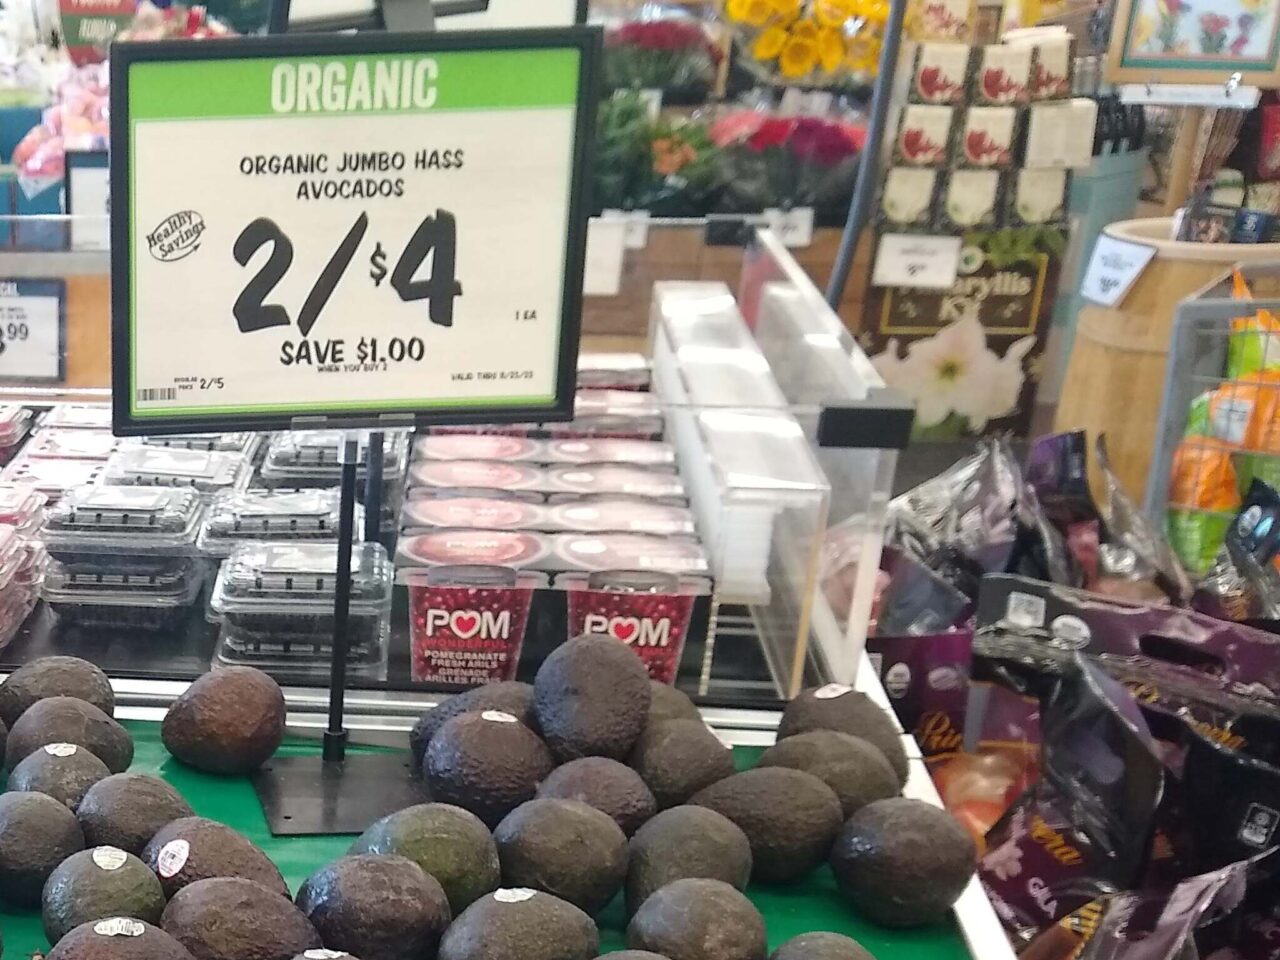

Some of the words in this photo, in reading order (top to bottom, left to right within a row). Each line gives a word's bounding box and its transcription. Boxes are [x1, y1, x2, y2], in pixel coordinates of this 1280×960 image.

[271, 59, 438, 114] ORGANIC
[240, 153, 328, 176] ORGANIC
[337, 152, 406, 173] JUMBO
[414, 149, 464, 170] HASS
[296, 178, 405, 200] AVOCADOS
[146, 209, 193, 248] Healthy
[158, 219, 207, 258] Savings
[280, 339, 345, 366] SAVE
[356, 336, 425, 364] $1.00
[425, 608, 511, 640] POM
[583, 613, 671, 647] POM
[424, 650, 507, 662] POMEGRANATE
[431, 658, 467, 668] FRESH
[468, 659, 498, 668] ARILS
[424, 674, 468, 684] ARILLES
[438, 668, 489, 678] GRENADE
